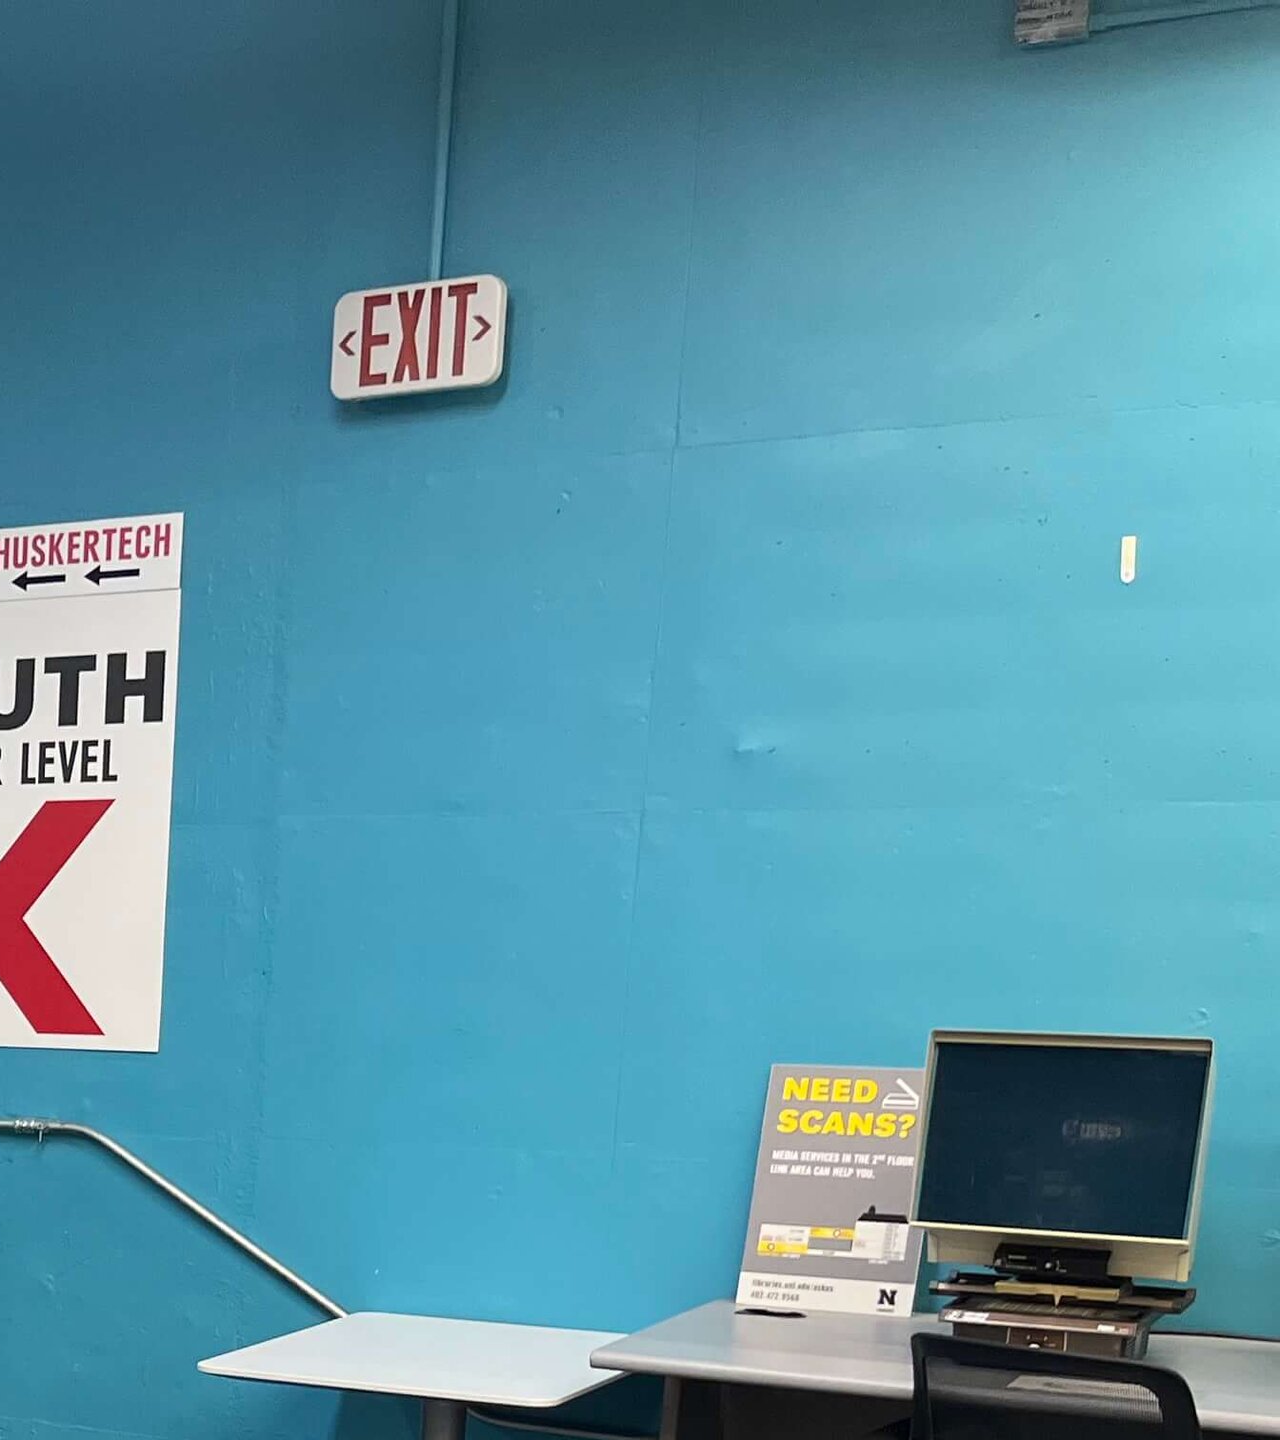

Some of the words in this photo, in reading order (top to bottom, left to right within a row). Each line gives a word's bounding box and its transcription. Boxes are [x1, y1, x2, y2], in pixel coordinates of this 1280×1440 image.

[359, 282, 478, 388] EXIT
[20, 739, 118, 785] LEVEL
[783, 1077, 878, 1103] NEED
[777, 1109, 916, 1138] SCANS?
[771, 1150, 799, 1160] MEDIA
[800, 1151, 840, 1163] SERVICES
[841, 1153, 852, 1164] IN
[853, 1153, 871, 1165] THE
[887, 1155, 914, 1167] FLOOR
[790, 1164, 812, 1176] AREA
[813, 1166, 831, 1176] CAN
[832, 1166, 854, 1178] HELP
[877, 1288, 898, 1306] N
